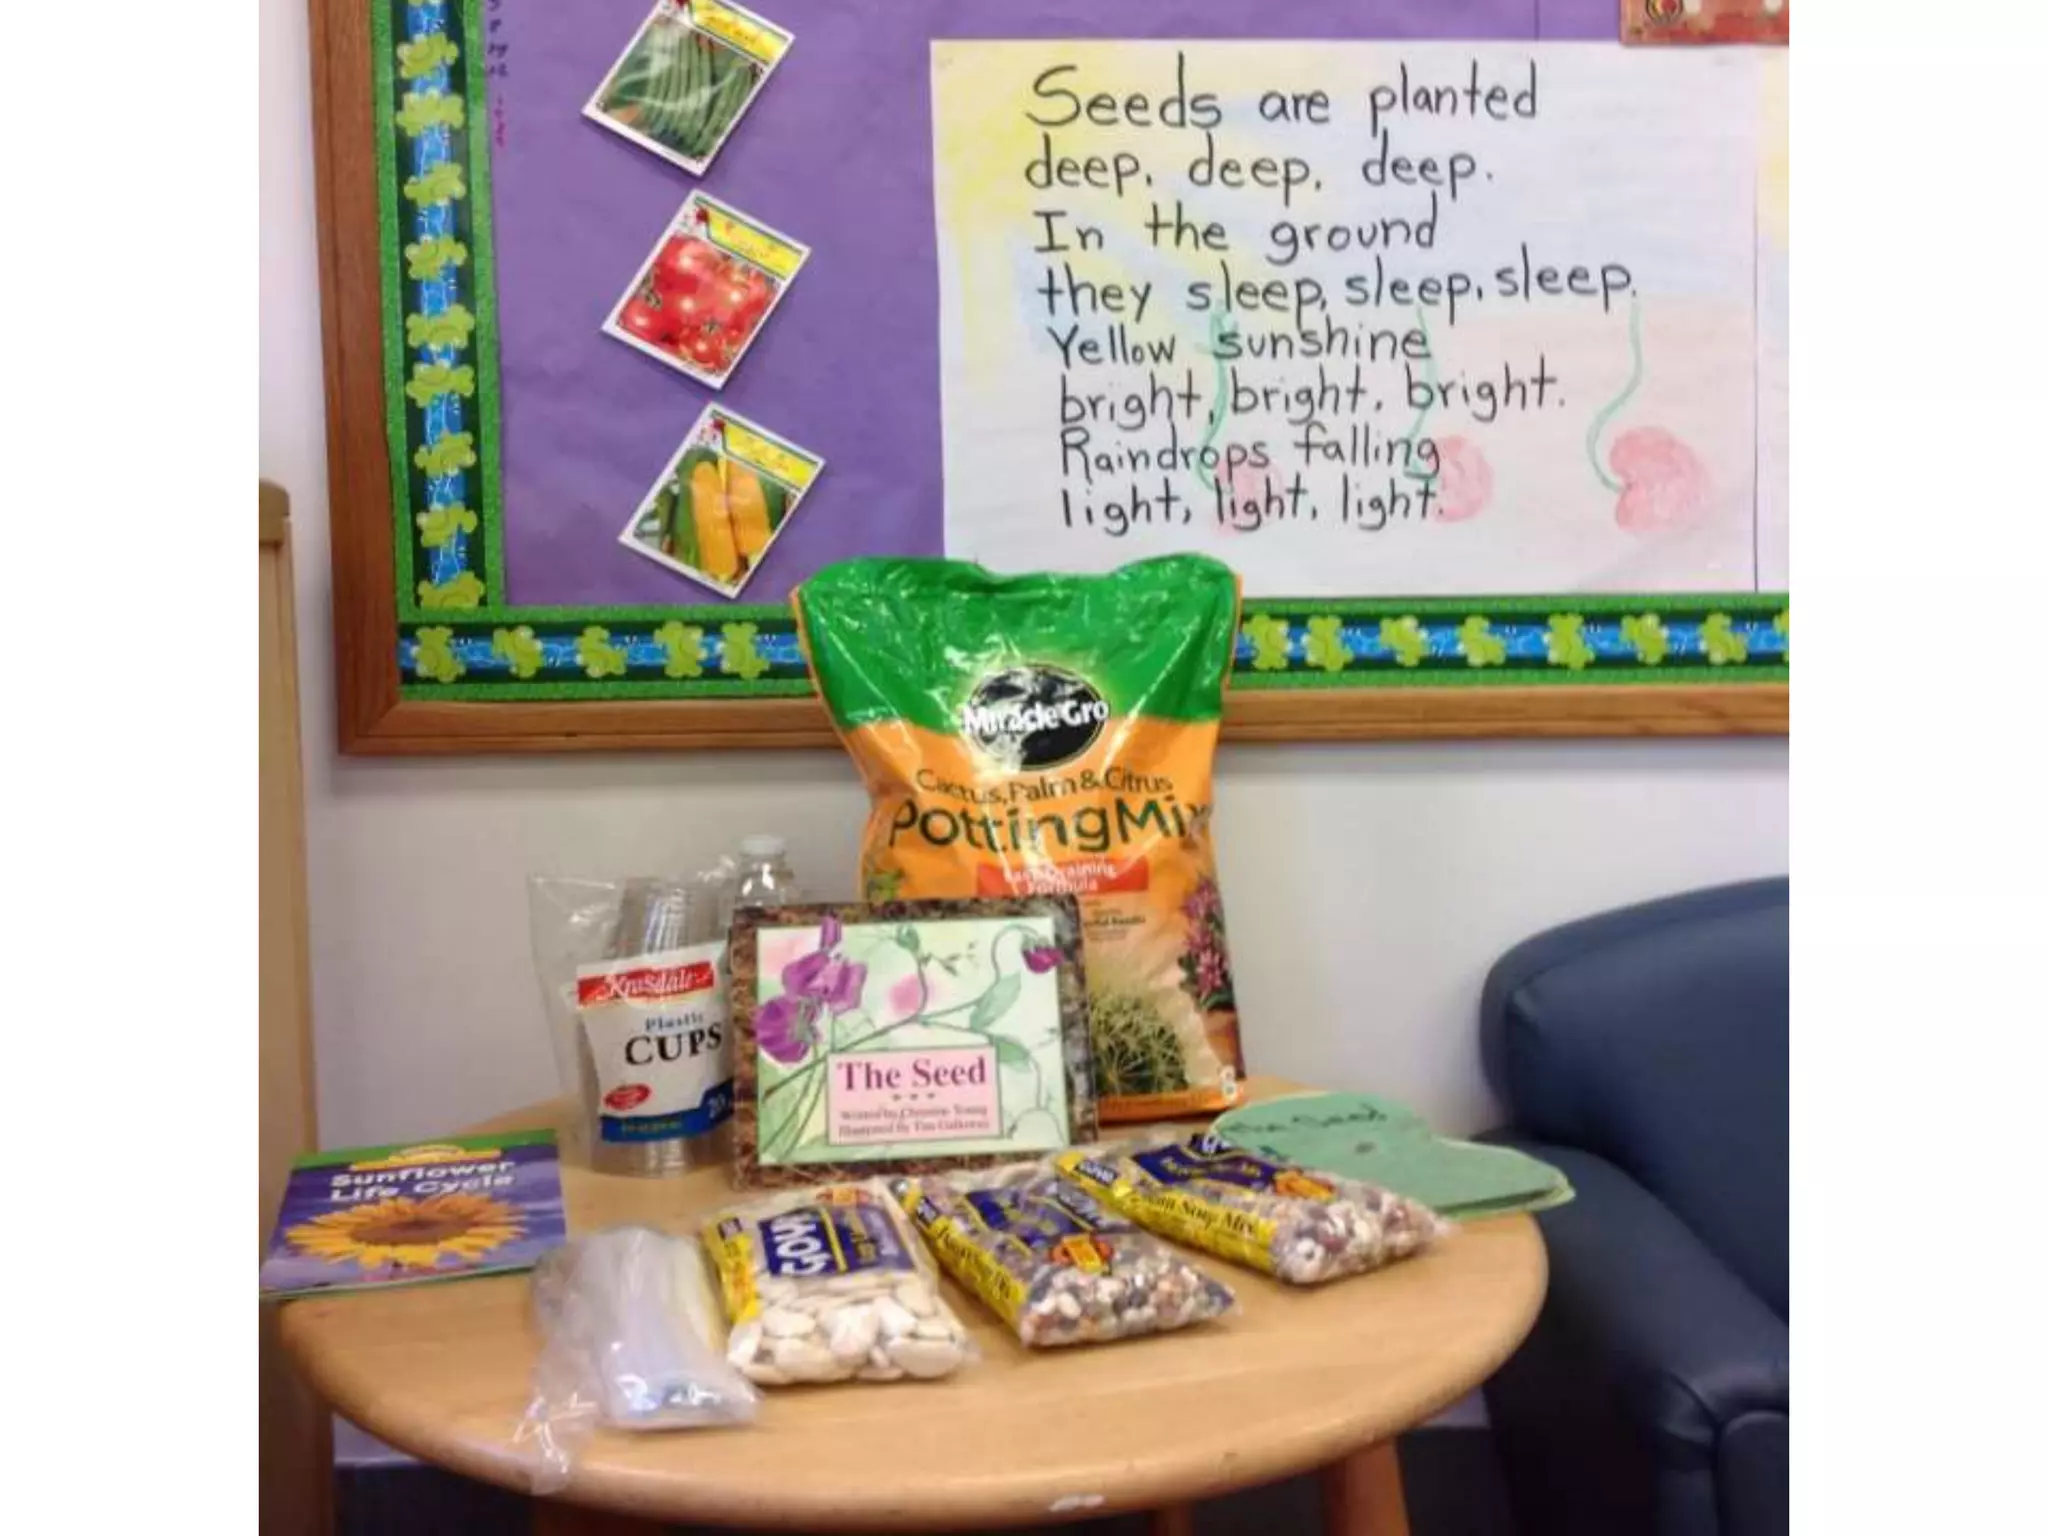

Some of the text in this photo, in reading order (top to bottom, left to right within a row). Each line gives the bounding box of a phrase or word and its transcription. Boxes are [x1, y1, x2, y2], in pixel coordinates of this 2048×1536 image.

[1025, 50, 1537, 138] Seeds are planted
[1033, 190, 1438, 266] In the ground
[1037, 261, 1152, 324] they
[1047, 313, 1431, 370] Yellow sunshine
[1061, 368, 1214, 432] bright,
[1404, 352, 1566, 423] bright.
[1060, 420, 1441, 485] Raindrops falling
[1061, 475, 1192, 537] light,
[1342, 472, 1444, 532] light.
[1080, 770, 1100, 790] &
[1104, 767, 1173, 793] Citrus
[888, 798, 1111, 853] Potting
[625, 1021, 723, 1066] CUPS
[645, 1011, 704, 1031] Plastic
[836, 1055, 986, 1091] The Seed
[330, 1161, 516, 1188] Sunflower
[330, 1173, 516, 1201] Life Cycle
